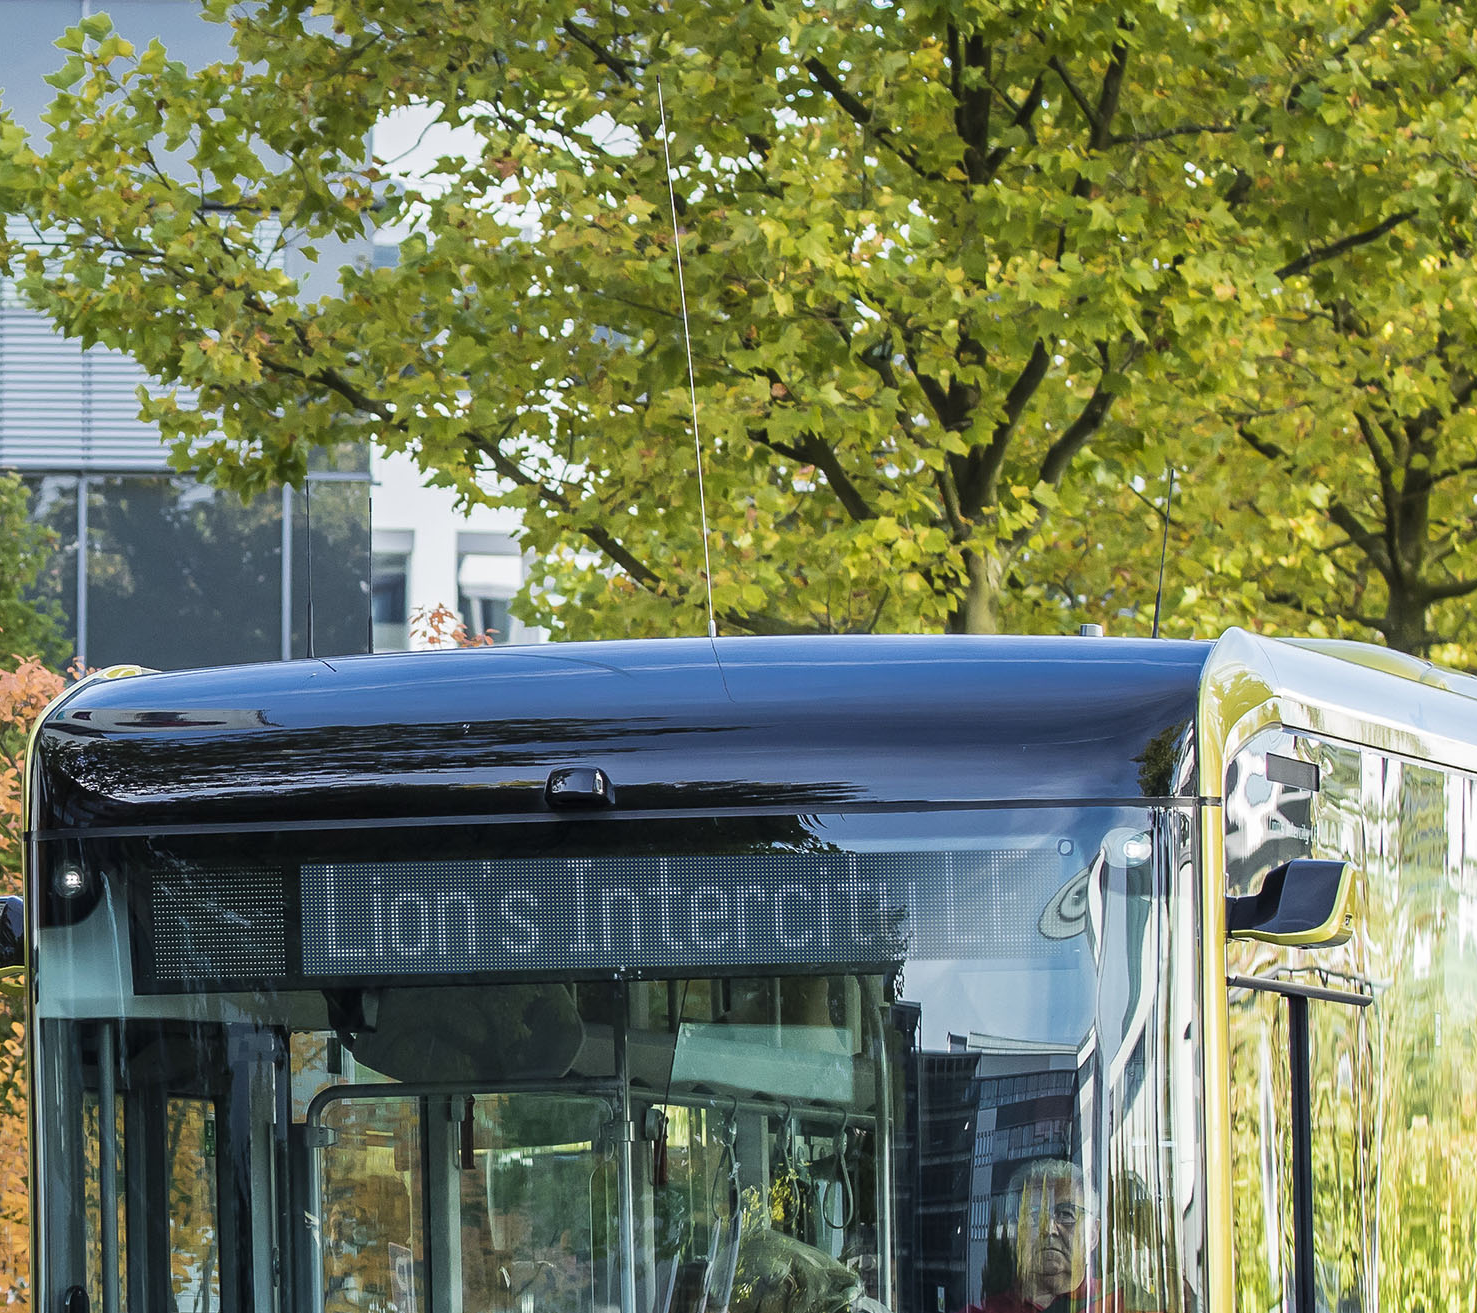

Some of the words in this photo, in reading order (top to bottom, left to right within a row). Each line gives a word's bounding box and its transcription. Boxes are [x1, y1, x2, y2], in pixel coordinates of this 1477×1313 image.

[325, 860, 539, 958] Lion's
[566, 854, 918, 956] Intercity
[945, 850, 1028, 943] LE
